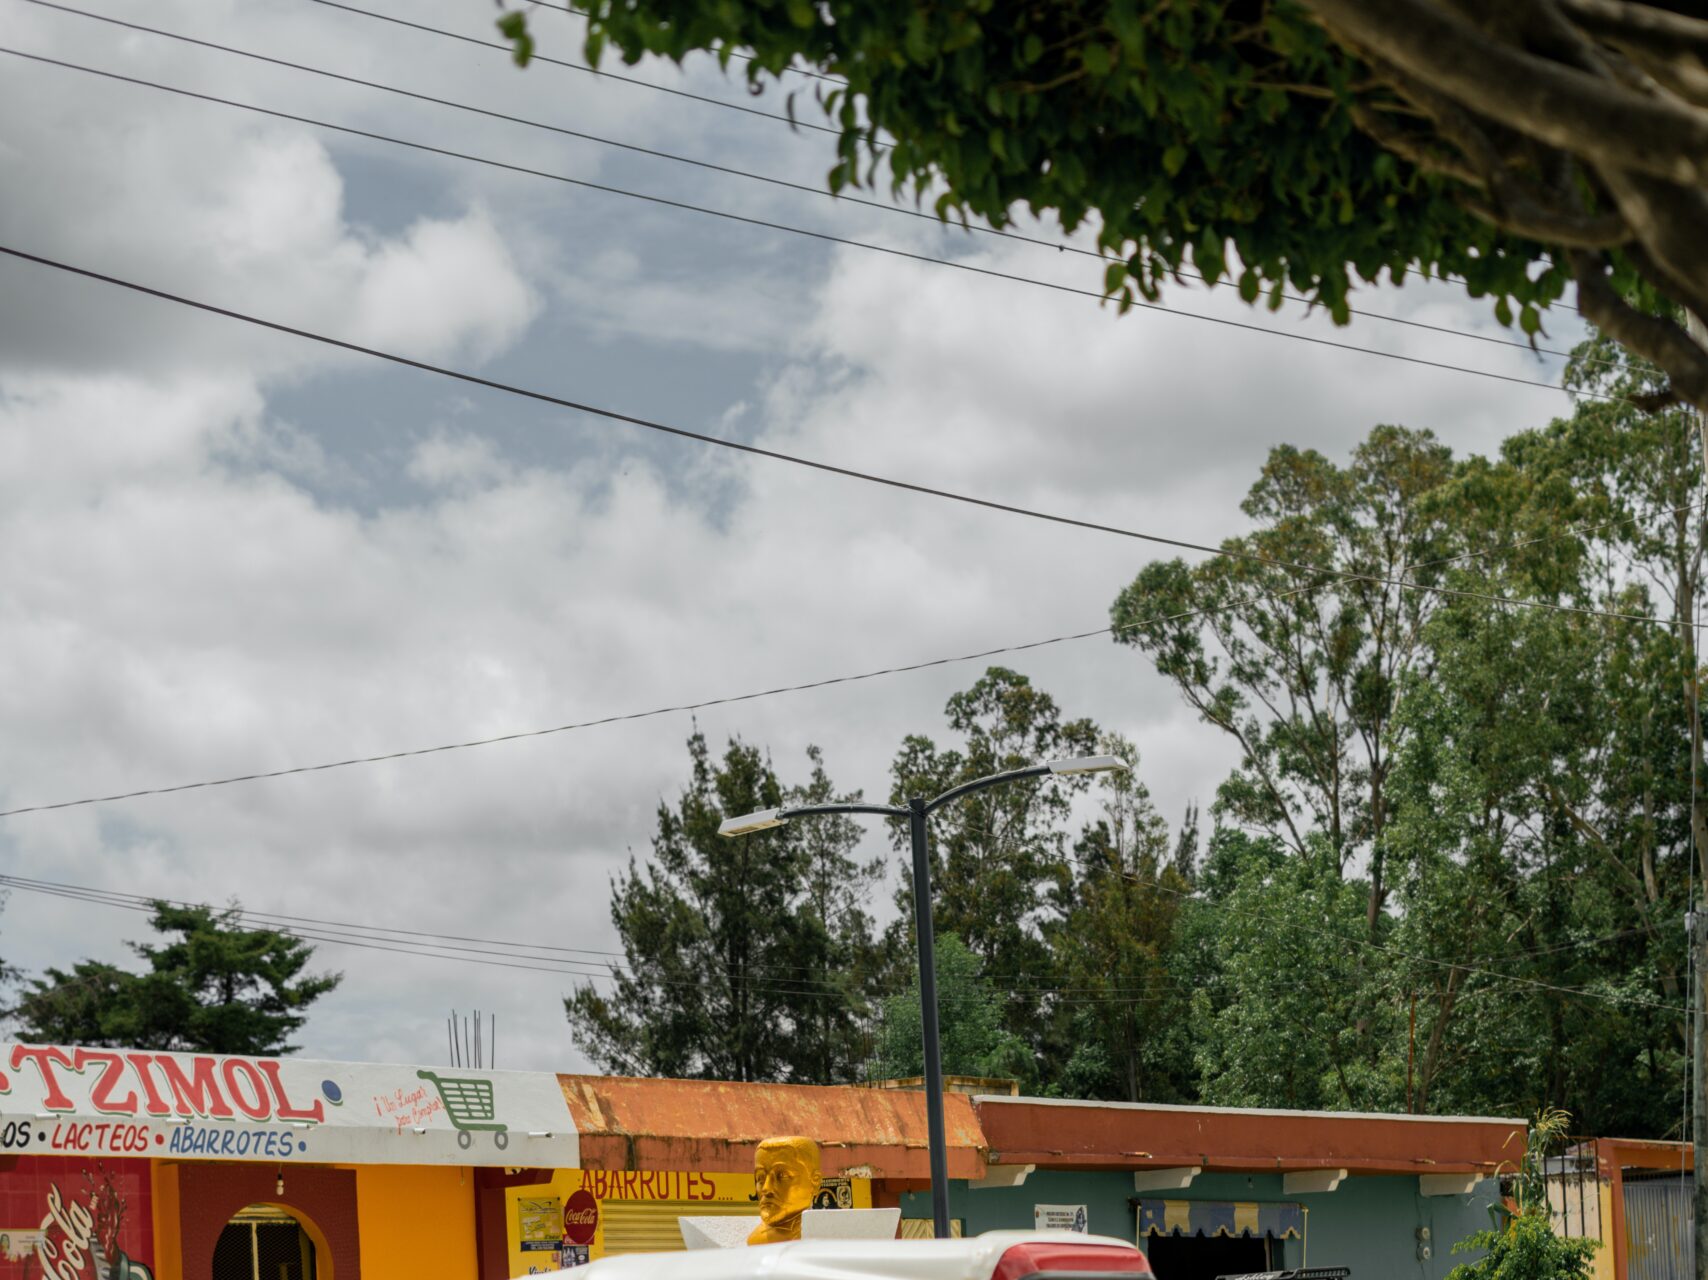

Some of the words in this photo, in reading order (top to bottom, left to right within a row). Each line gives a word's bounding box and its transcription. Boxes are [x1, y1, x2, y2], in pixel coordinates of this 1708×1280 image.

[9, 1044, 325, 1123] TZIMOL
[51, 1123, 149, 1152] LACTEOS
[170, 1126, 293, 1156] ABARROTES
[565, 1208, 597, 1225] Coca-Cola
